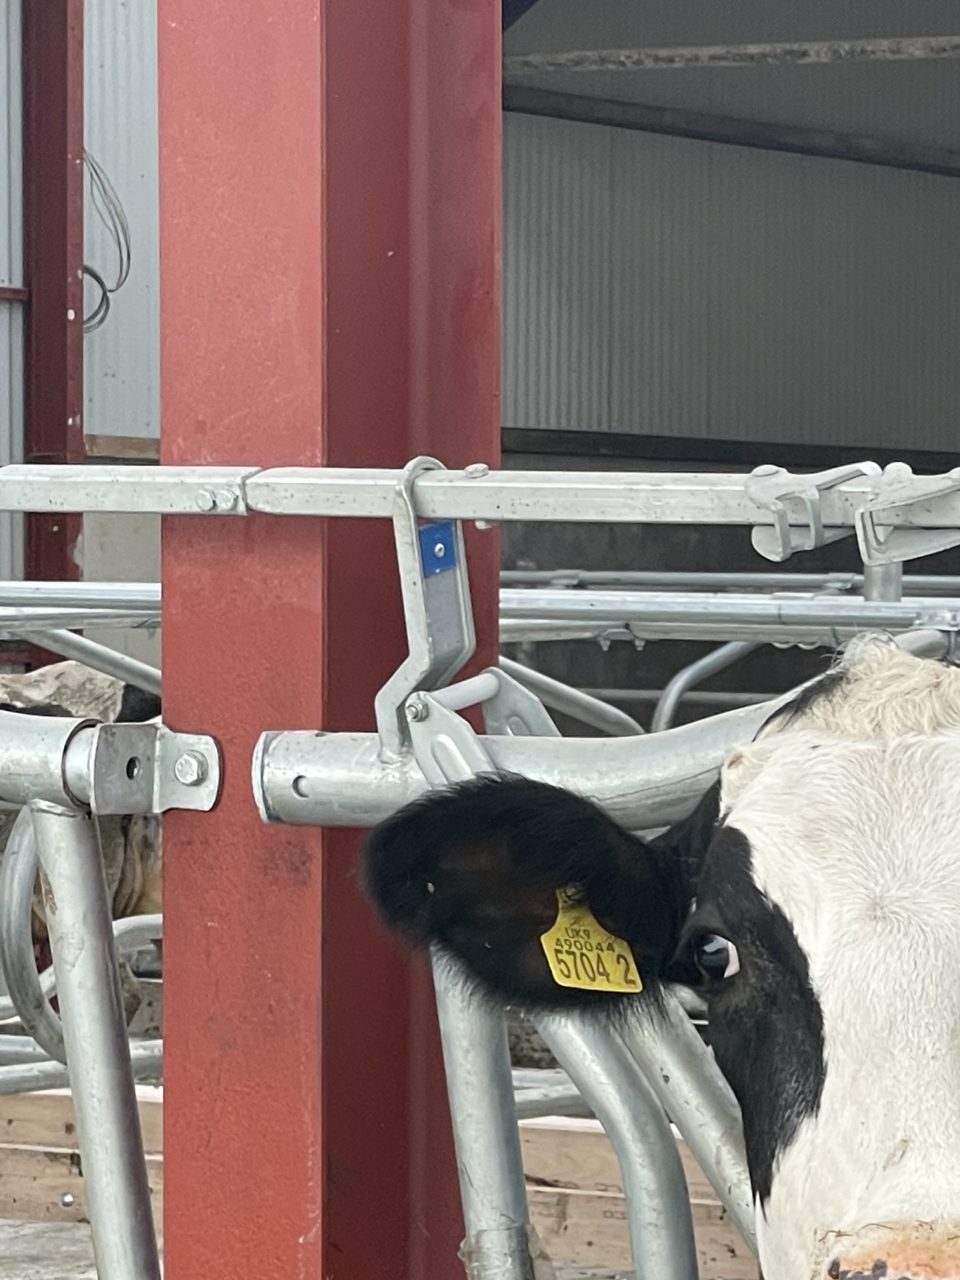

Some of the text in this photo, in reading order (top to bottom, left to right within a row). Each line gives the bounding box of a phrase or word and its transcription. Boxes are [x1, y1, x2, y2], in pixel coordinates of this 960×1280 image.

[565, 927, 591, 940] UK9
[555, 938, 616, 953] 490044
[554, 949, 637, 985] 5704 2
